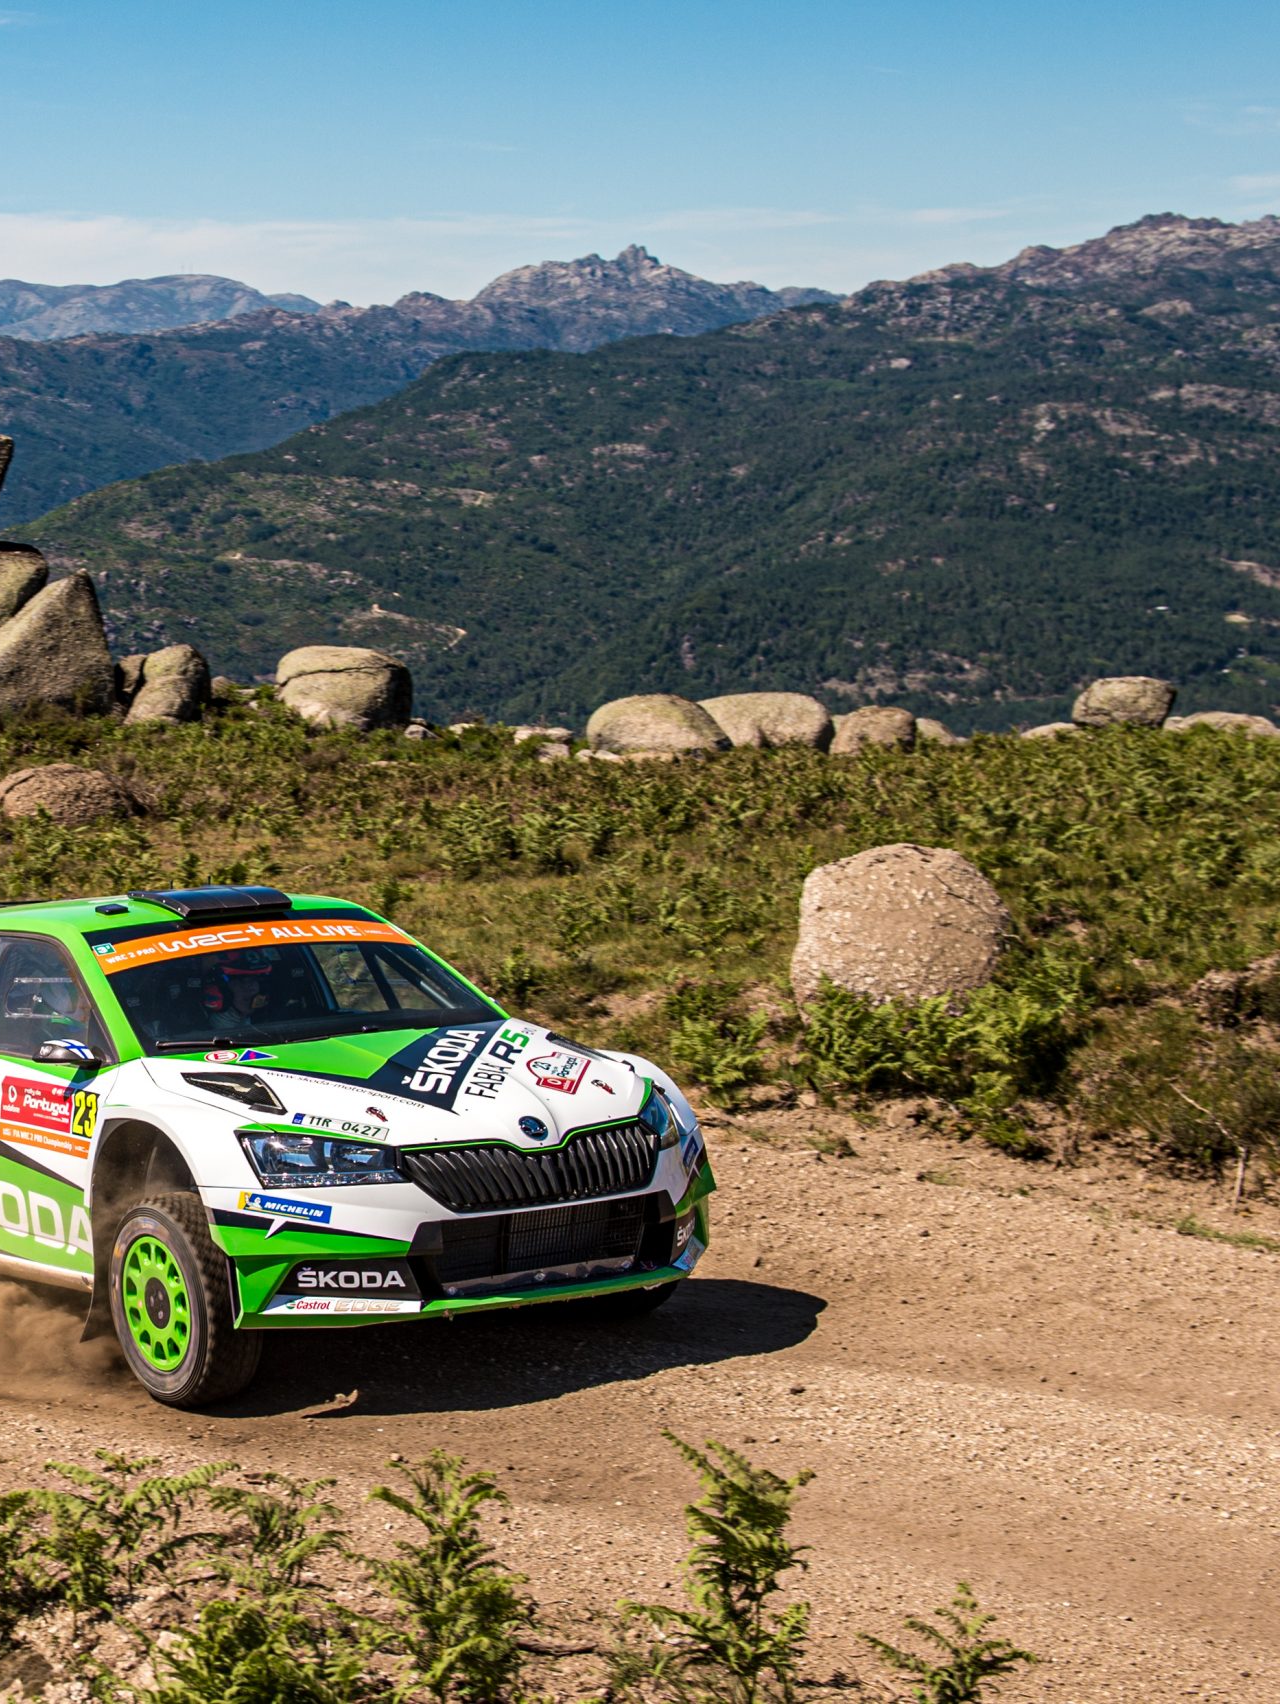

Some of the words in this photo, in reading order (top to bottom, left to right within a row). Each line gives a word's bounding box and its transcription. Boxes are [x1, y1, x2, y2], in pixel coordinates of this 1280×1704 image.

[137, 947, 156, 956] PRO
[271, 926, 313, 938] ALL
[311, 925, 362, 936] LIVE
[488, 1029, 531, 1066] R5
[401, 1029, 486, 1095] ŠKODA
[556, 1056, 578, 1078] Portugal
[266, 1071, 425, 1109] www.skoda-motorsport.com
[23, 1094, 70, 1116] Portugal
[72, 1090, 98, 1137] 23
[341, 1121, 381, 1137] 0427
[264, 1201, 324, 1217] MICHELIN
[298, 1267, 406, 1288] ŠKODA
[296, 1300, 330, 1310] Castrol
[334, 1299, 404, 1312] EDGE
